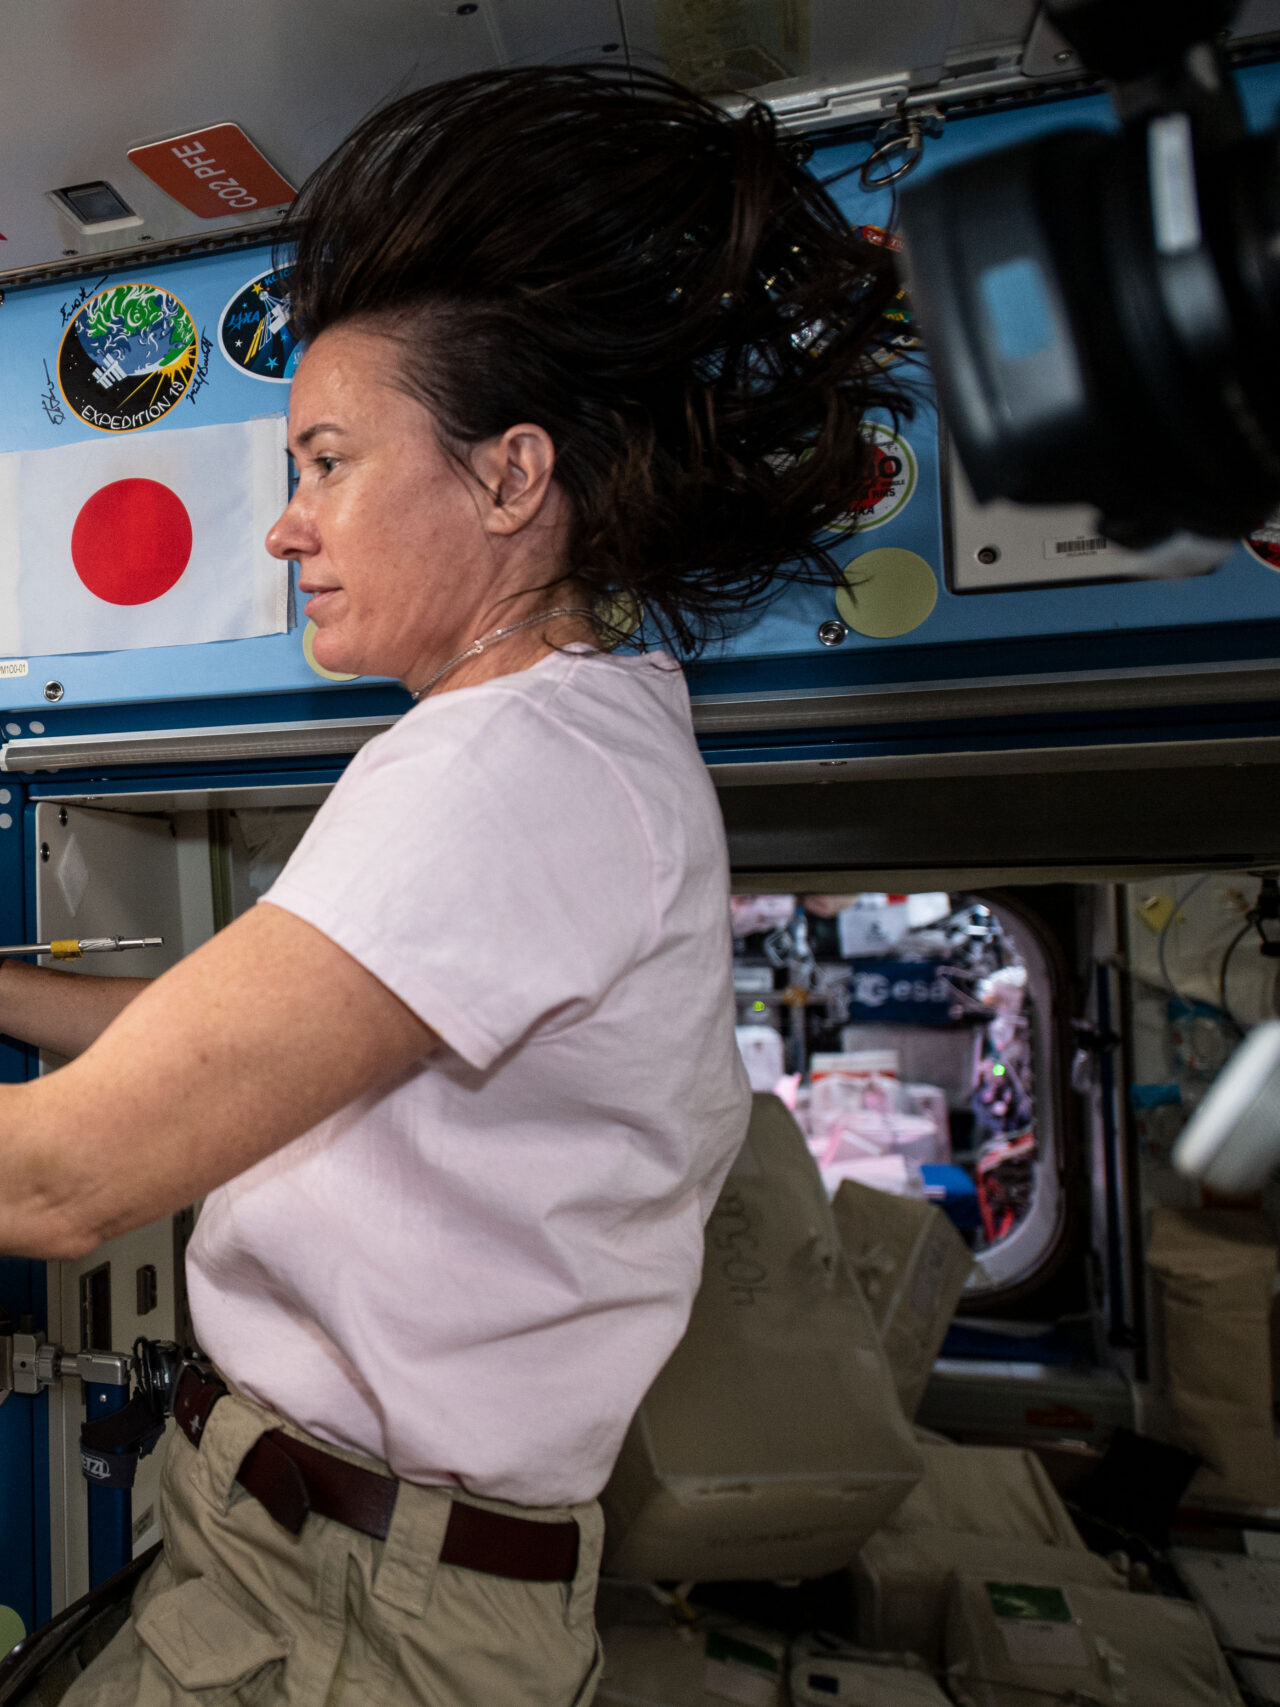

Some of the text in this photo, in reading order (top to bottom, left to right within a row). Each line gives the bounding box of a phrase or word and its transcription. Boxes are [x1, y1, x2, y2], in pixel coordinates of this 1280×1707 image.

[171, 140, 226, 179] PFE
[81, 380, 185, 430] EXPEDITION 19
